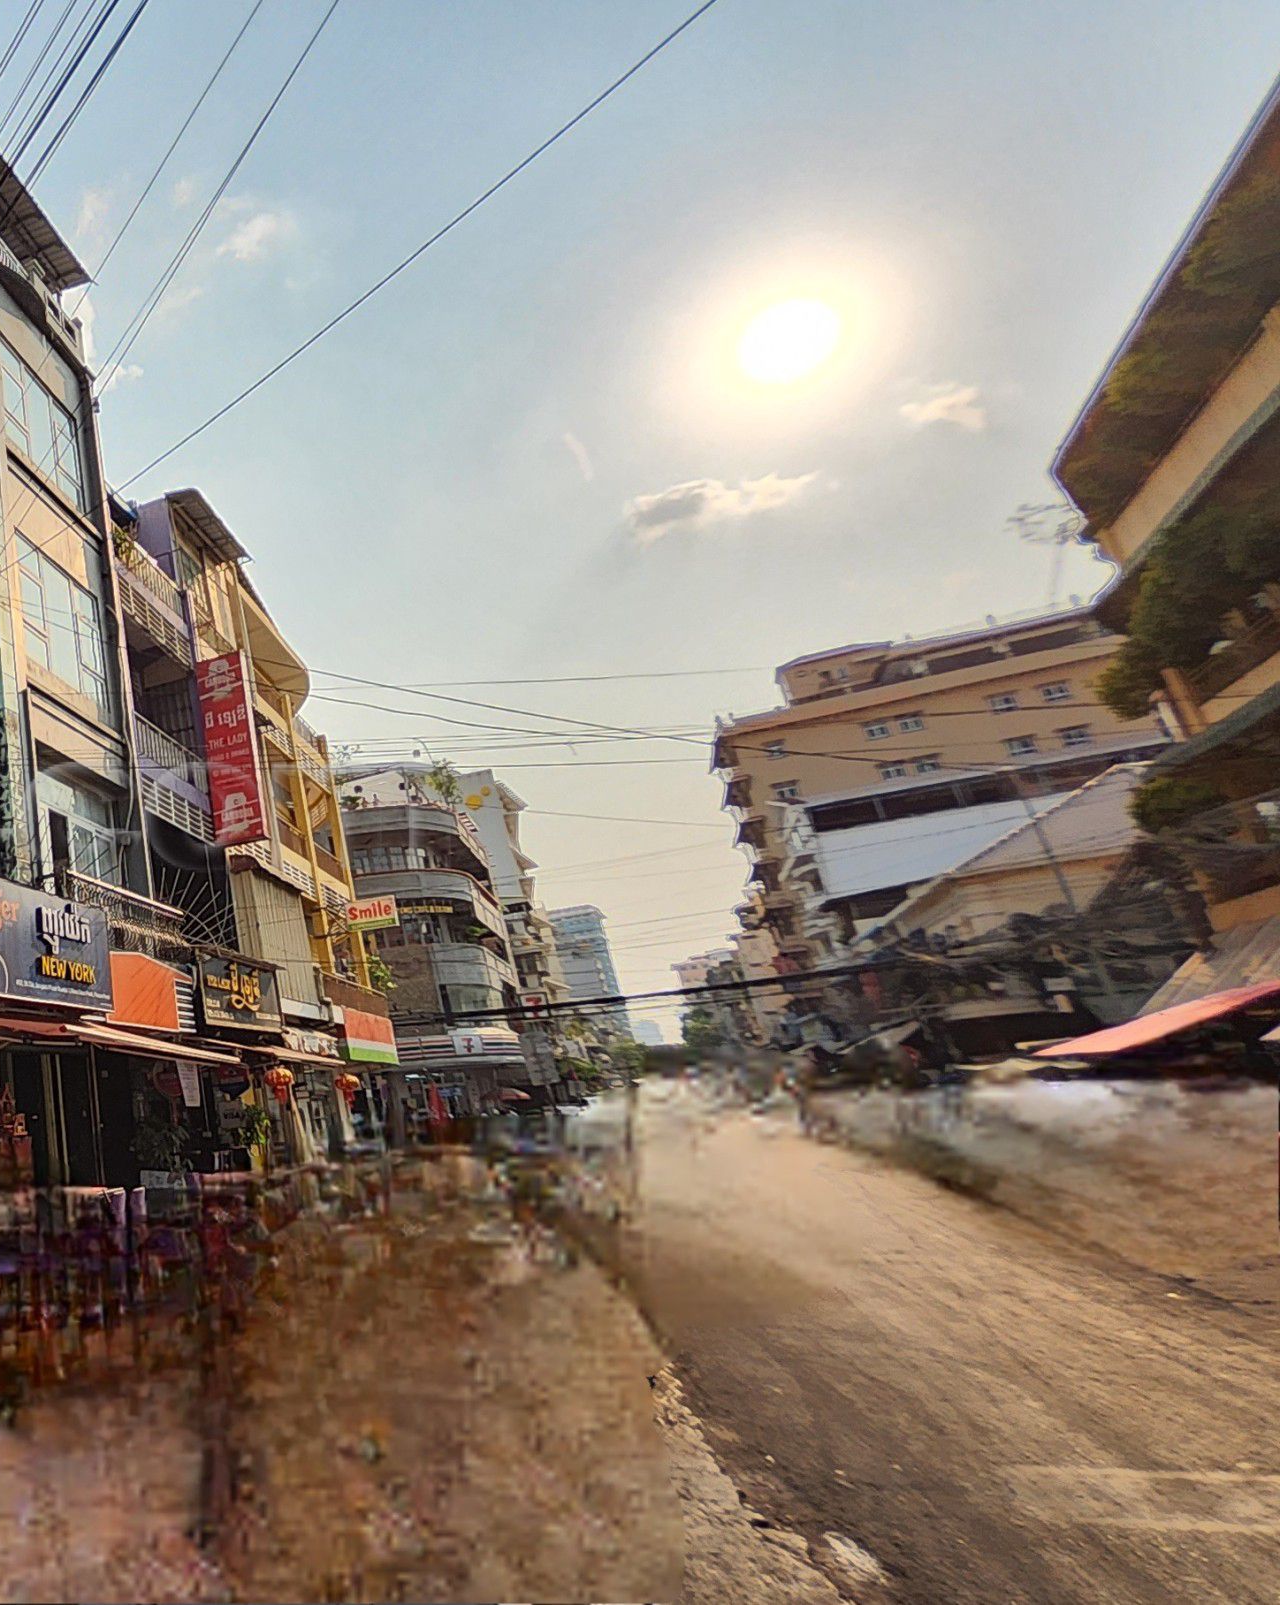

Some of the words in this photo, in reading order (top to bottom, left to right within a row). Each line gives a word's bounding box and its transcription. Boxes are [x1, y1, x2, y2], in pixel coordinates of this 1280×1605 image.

[208, 737, 226, 750] THE
[227, 732, 248, 746] LADY
[348, 900, 392, 921] Smile
[41, 955, 67, 979] NEW
[68, 960, 97, 985] YORK
